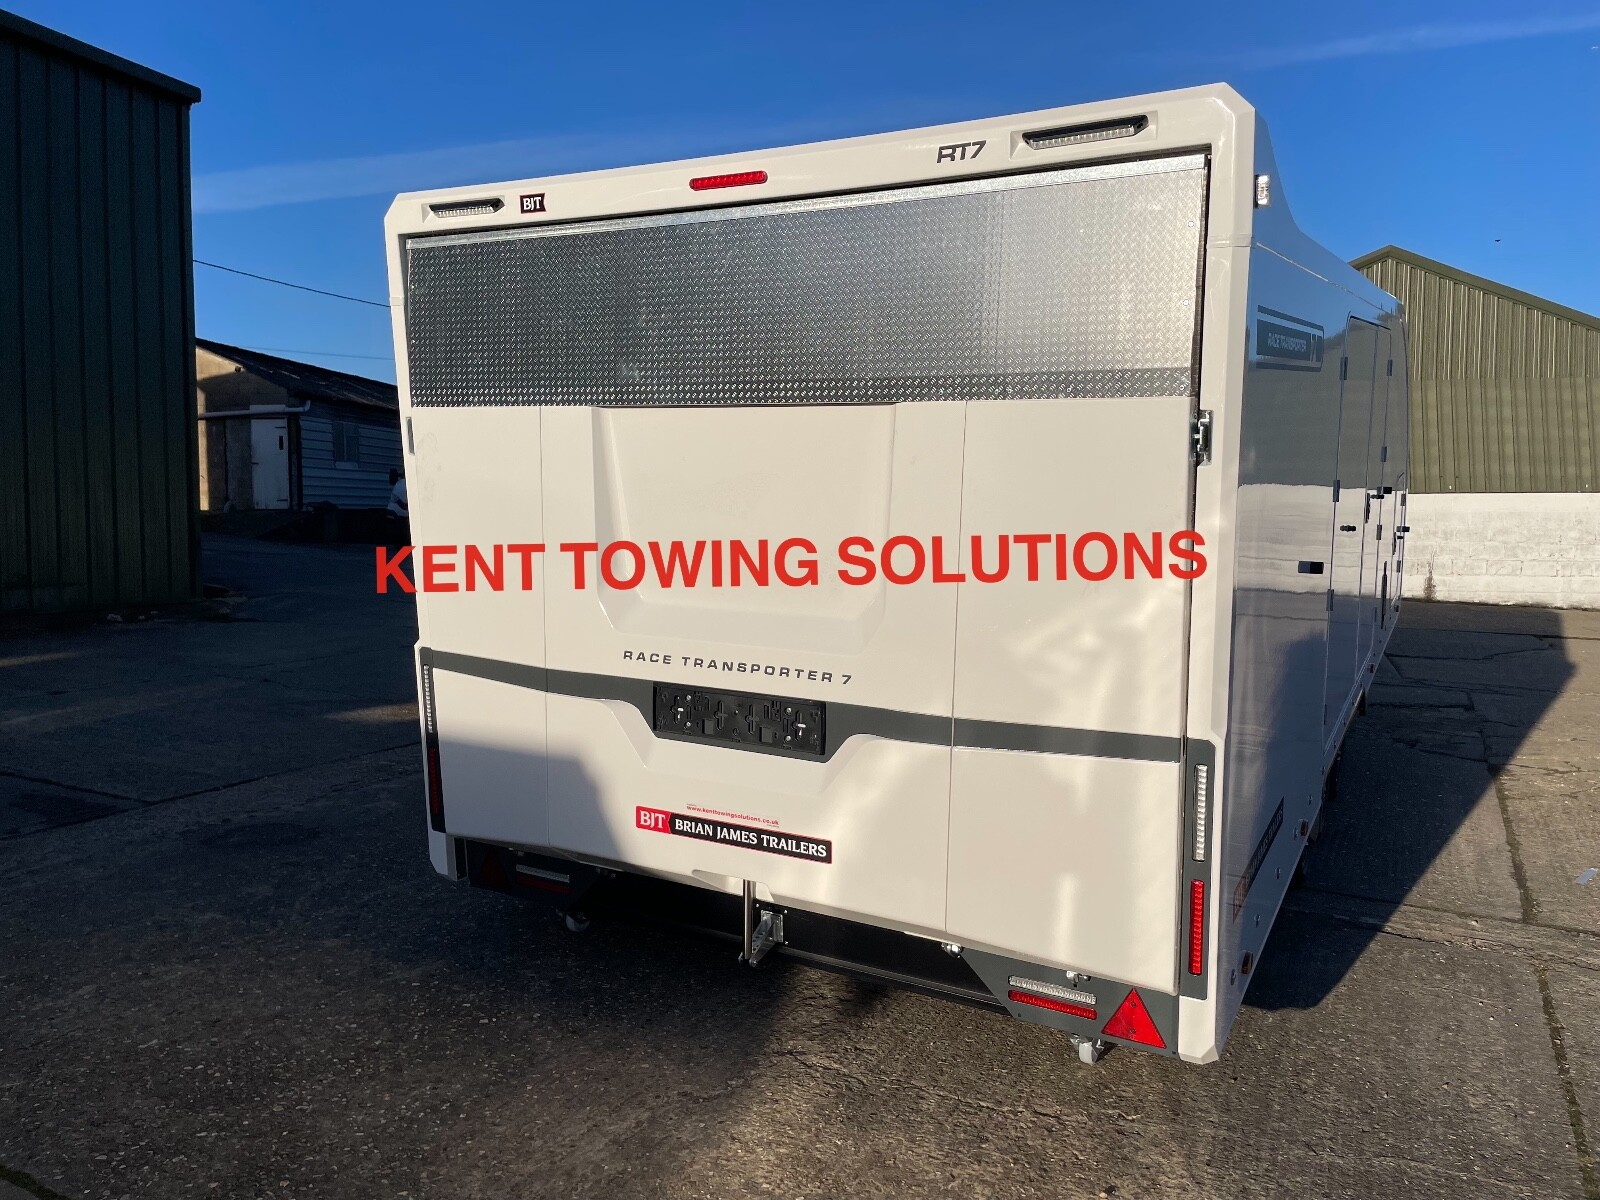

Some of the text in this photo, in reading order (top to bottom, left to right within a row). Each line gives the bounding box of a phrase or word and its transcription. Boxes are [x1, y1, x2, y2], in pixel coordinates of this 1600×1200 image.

[936, 139, 987, 164] RT7
[523, 196, 542, 211] BJT
[623, 650, 853, 686] RACE TRANSPORTER 7
[686, 805, 780, 825] www.kenttowingsolutions.co.uk
[639, 810, 827, 858] BJT BRIAN JAMES TRAILERS
